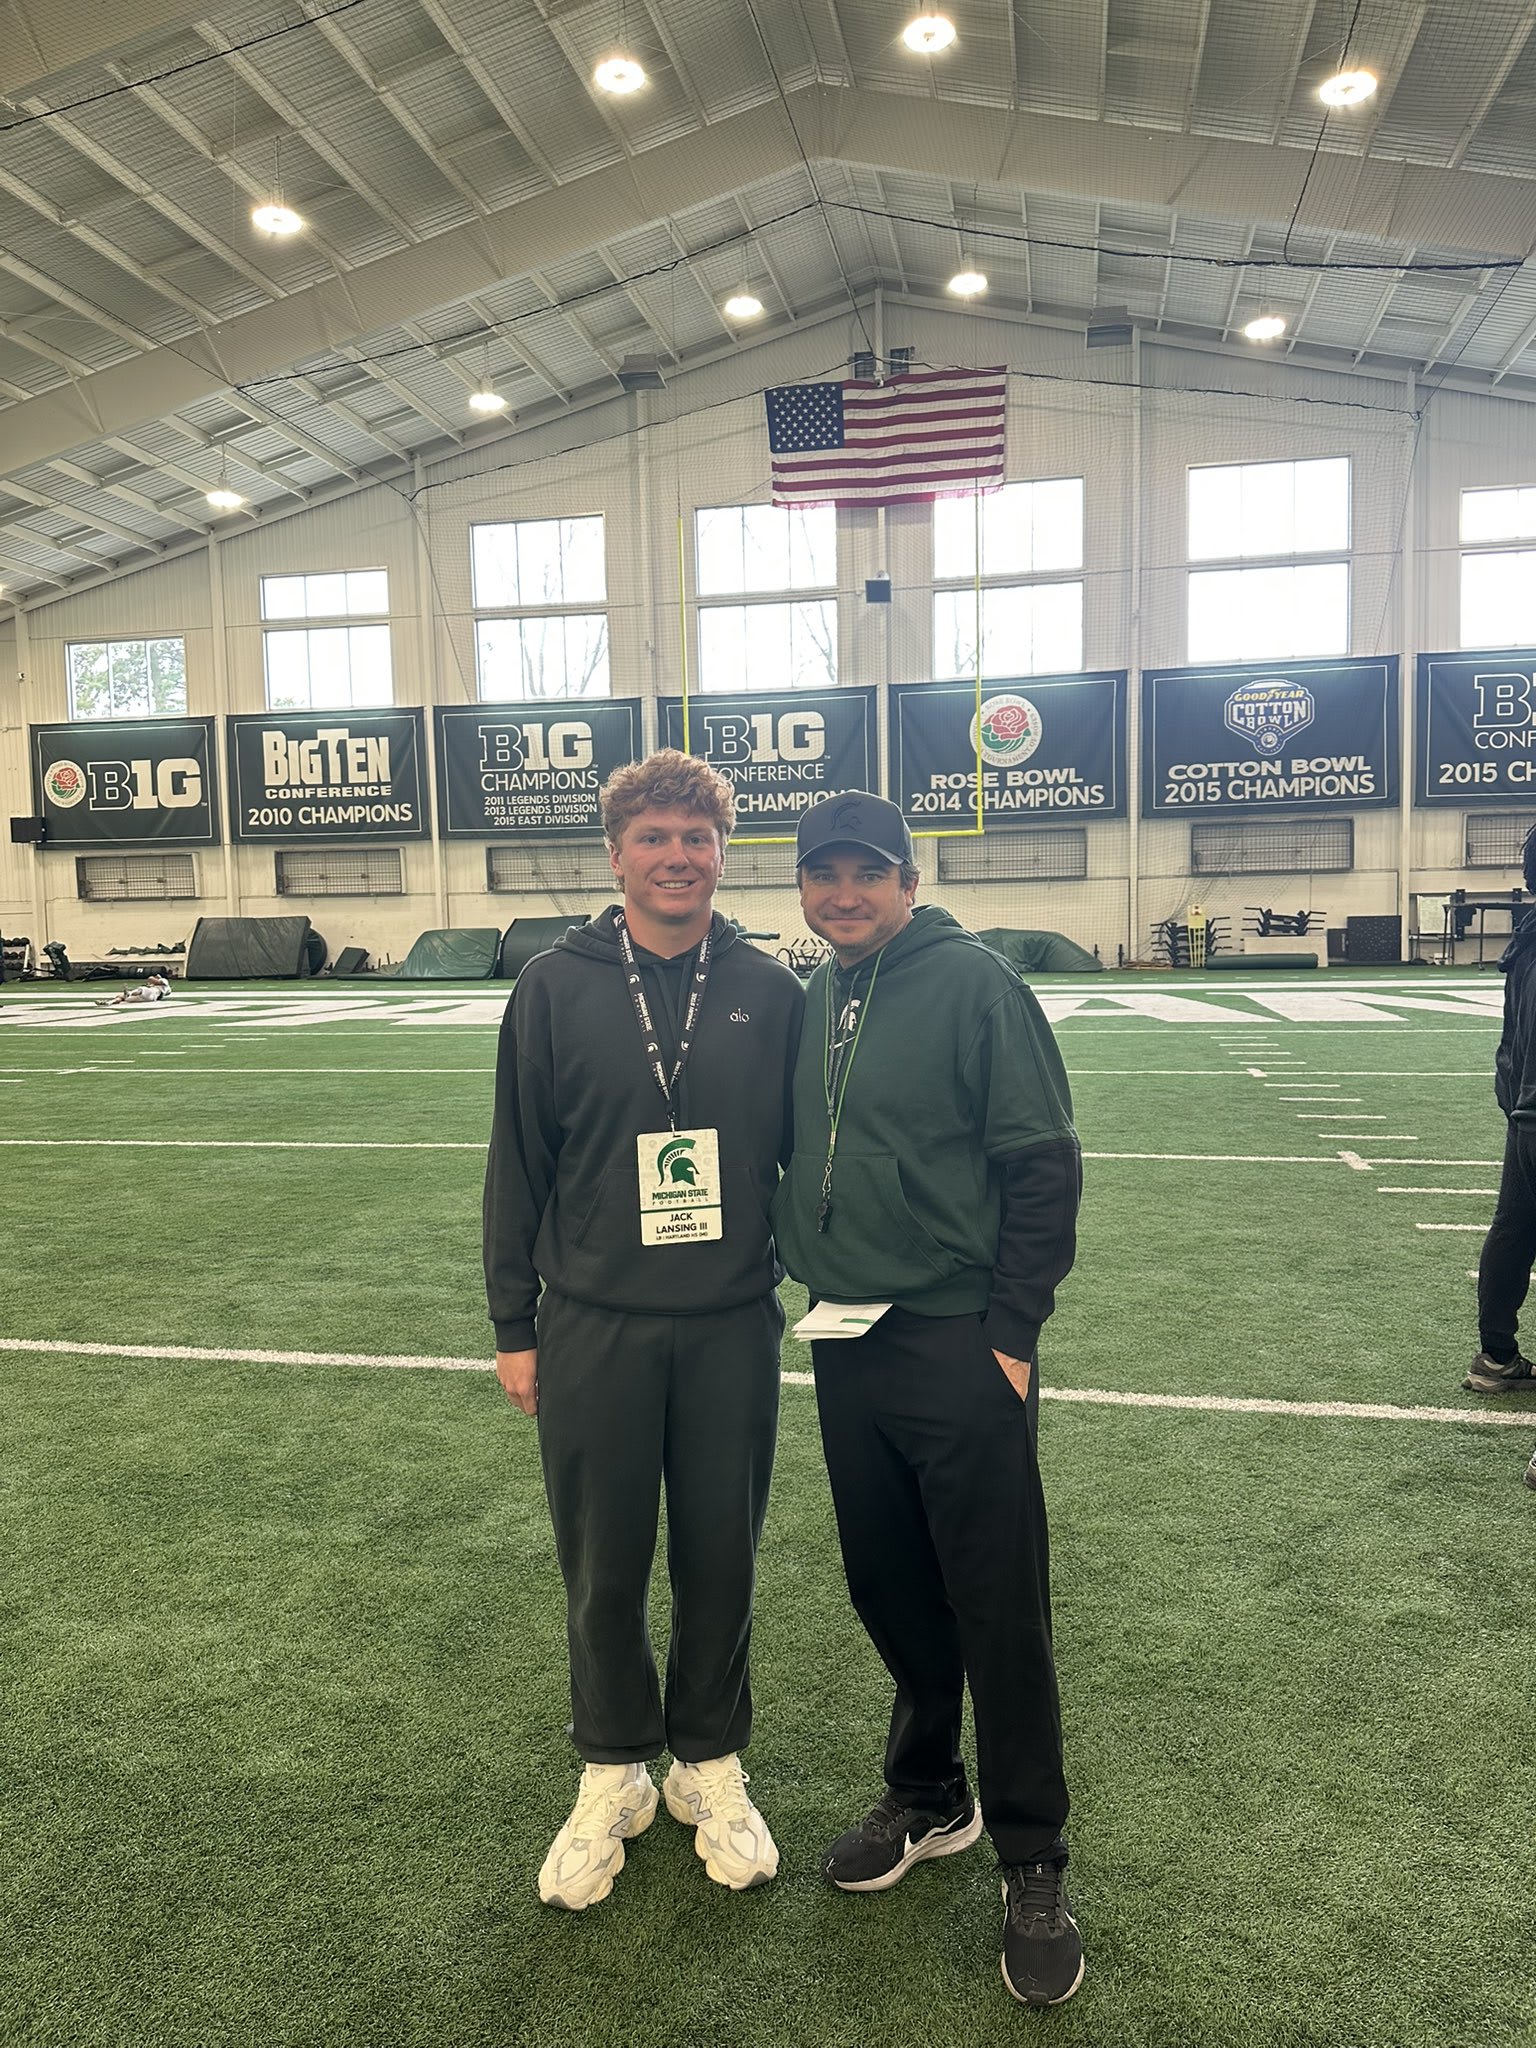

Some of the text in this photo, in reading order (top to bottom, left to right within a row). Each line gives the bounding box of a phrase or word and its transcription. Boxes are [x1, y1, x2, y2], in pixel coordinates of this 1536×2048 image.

[1234, 689, 1305, 702] GOODYEAR
[1232, 700, 1307, 726] COTTON
[1246, 715, 1293, 730] BOWL
[714, 763, 824, 783] ONFERENCE
[1168, 756, 1371, 780] COTTON BOWL
[1438, 762, 1498, 784] 2015
[481, 770, 599, 792] CHAMPIONS
[930, 767, 1084, 789] ROSE BOWL
[265, 785, 392, 800] CONFERENCE
[1165, 773, 1375, 803] 2015 CHAMPIONS
[484, 793, 596, 806] 2011 LEGENDS DIVISION
[911, 784, 1105, 812] 2014 CHAMPIONS
[248, 803, 413, 826] 2010 CHAMPIONS
[484, 803, 597, 816] 2013 LEGENDS DIVISION
[493, 814, 589, 826] 2015 EAST DIVISION
[729, 1007, 750, 1023] alo
[652, 1188, 708, 1200] MICHIGAN STATE
[652, 1198, 709, 1206] FOOTBALL
[670, 1212, 693, 1222] JACK
[656, 1222, 708, 1234] LANSING III
